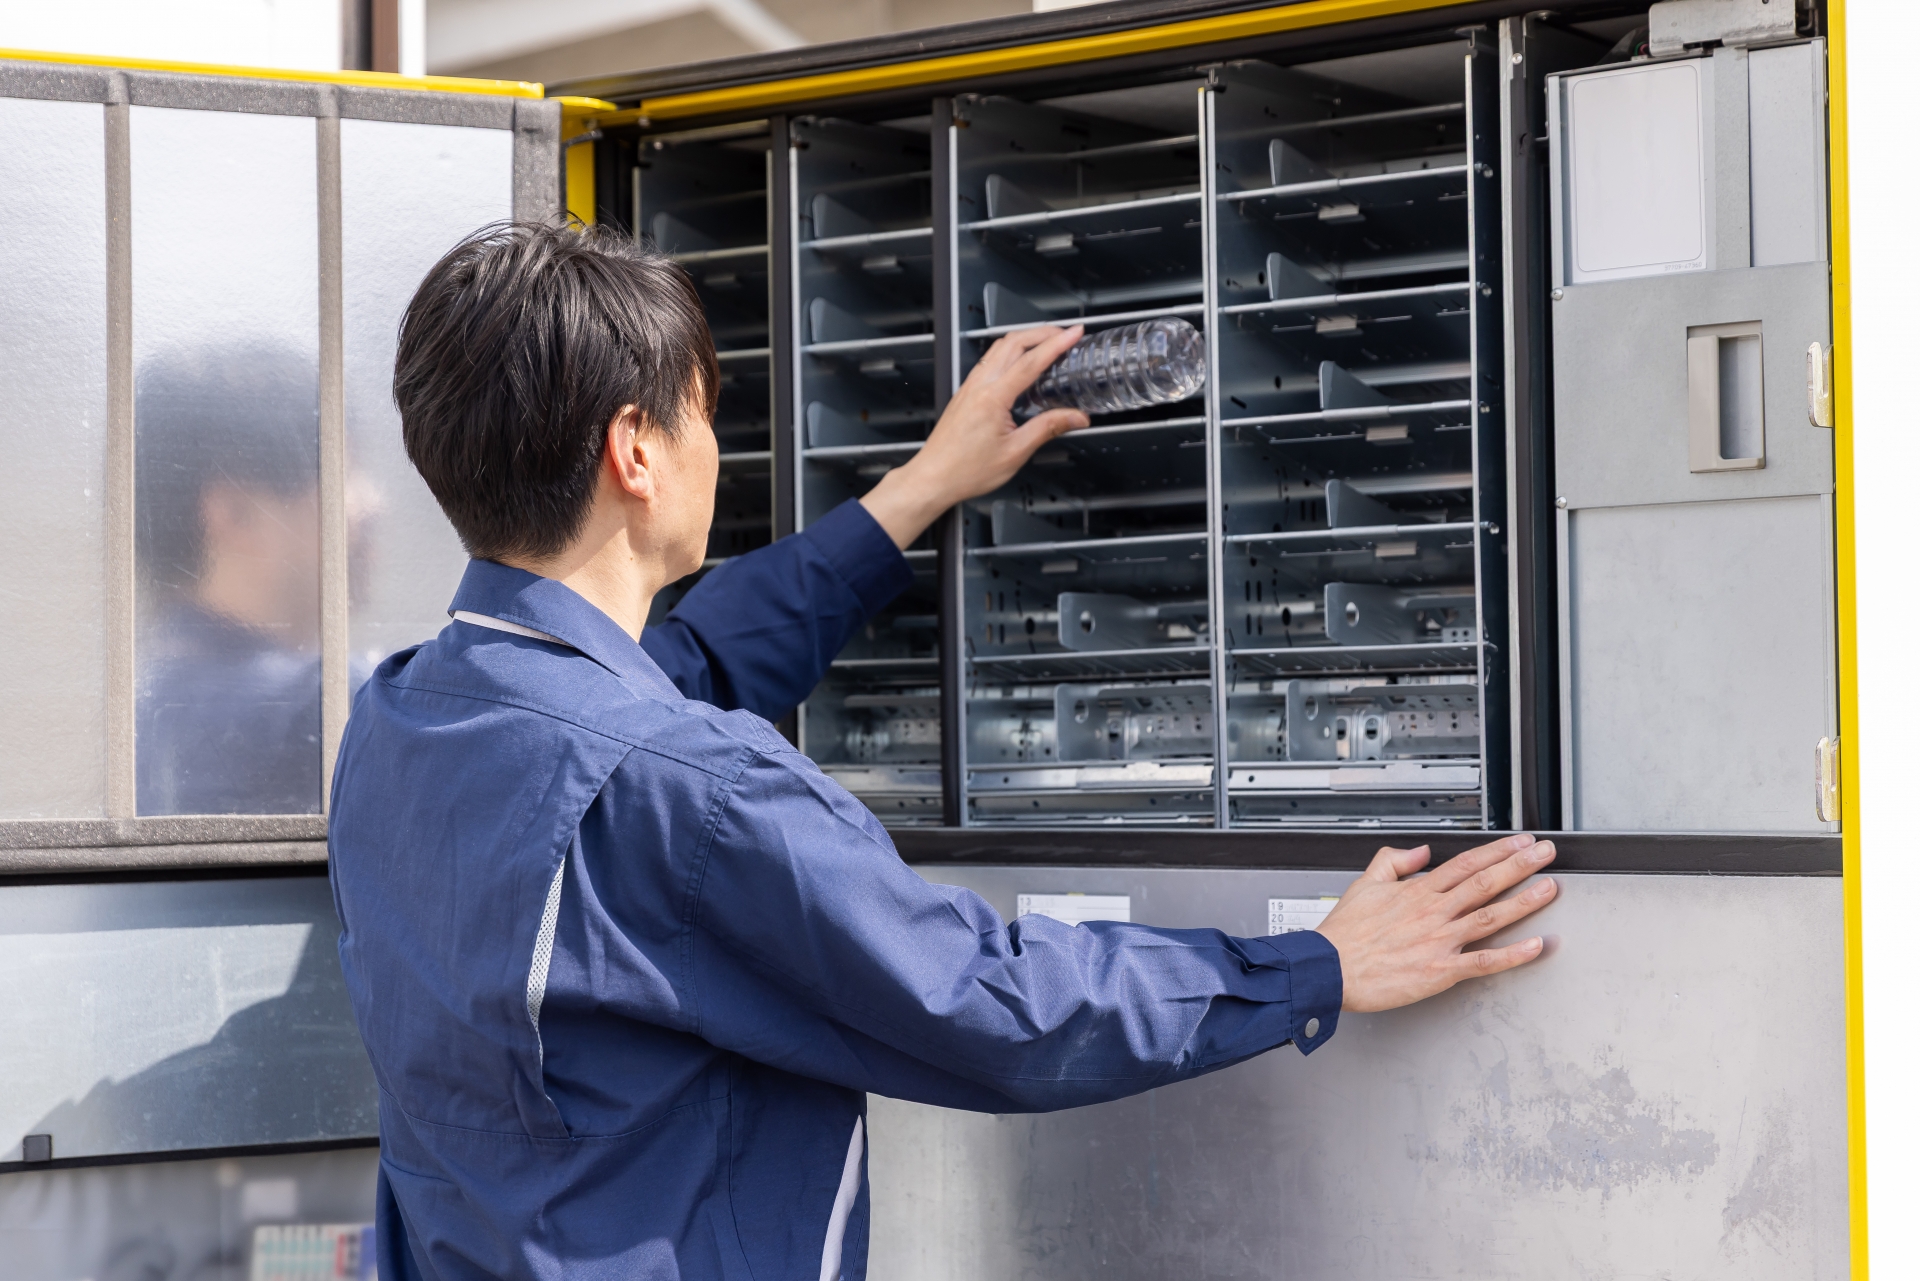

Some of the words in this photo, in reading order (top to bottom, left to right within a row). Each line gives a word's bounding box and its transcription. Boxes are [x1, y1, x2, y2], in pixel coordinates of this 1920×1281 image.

[1271, 901, 1284, 911] 19
[1271, 913, 1284, 923] 20
[1271, 925, 1283, 935] 21
